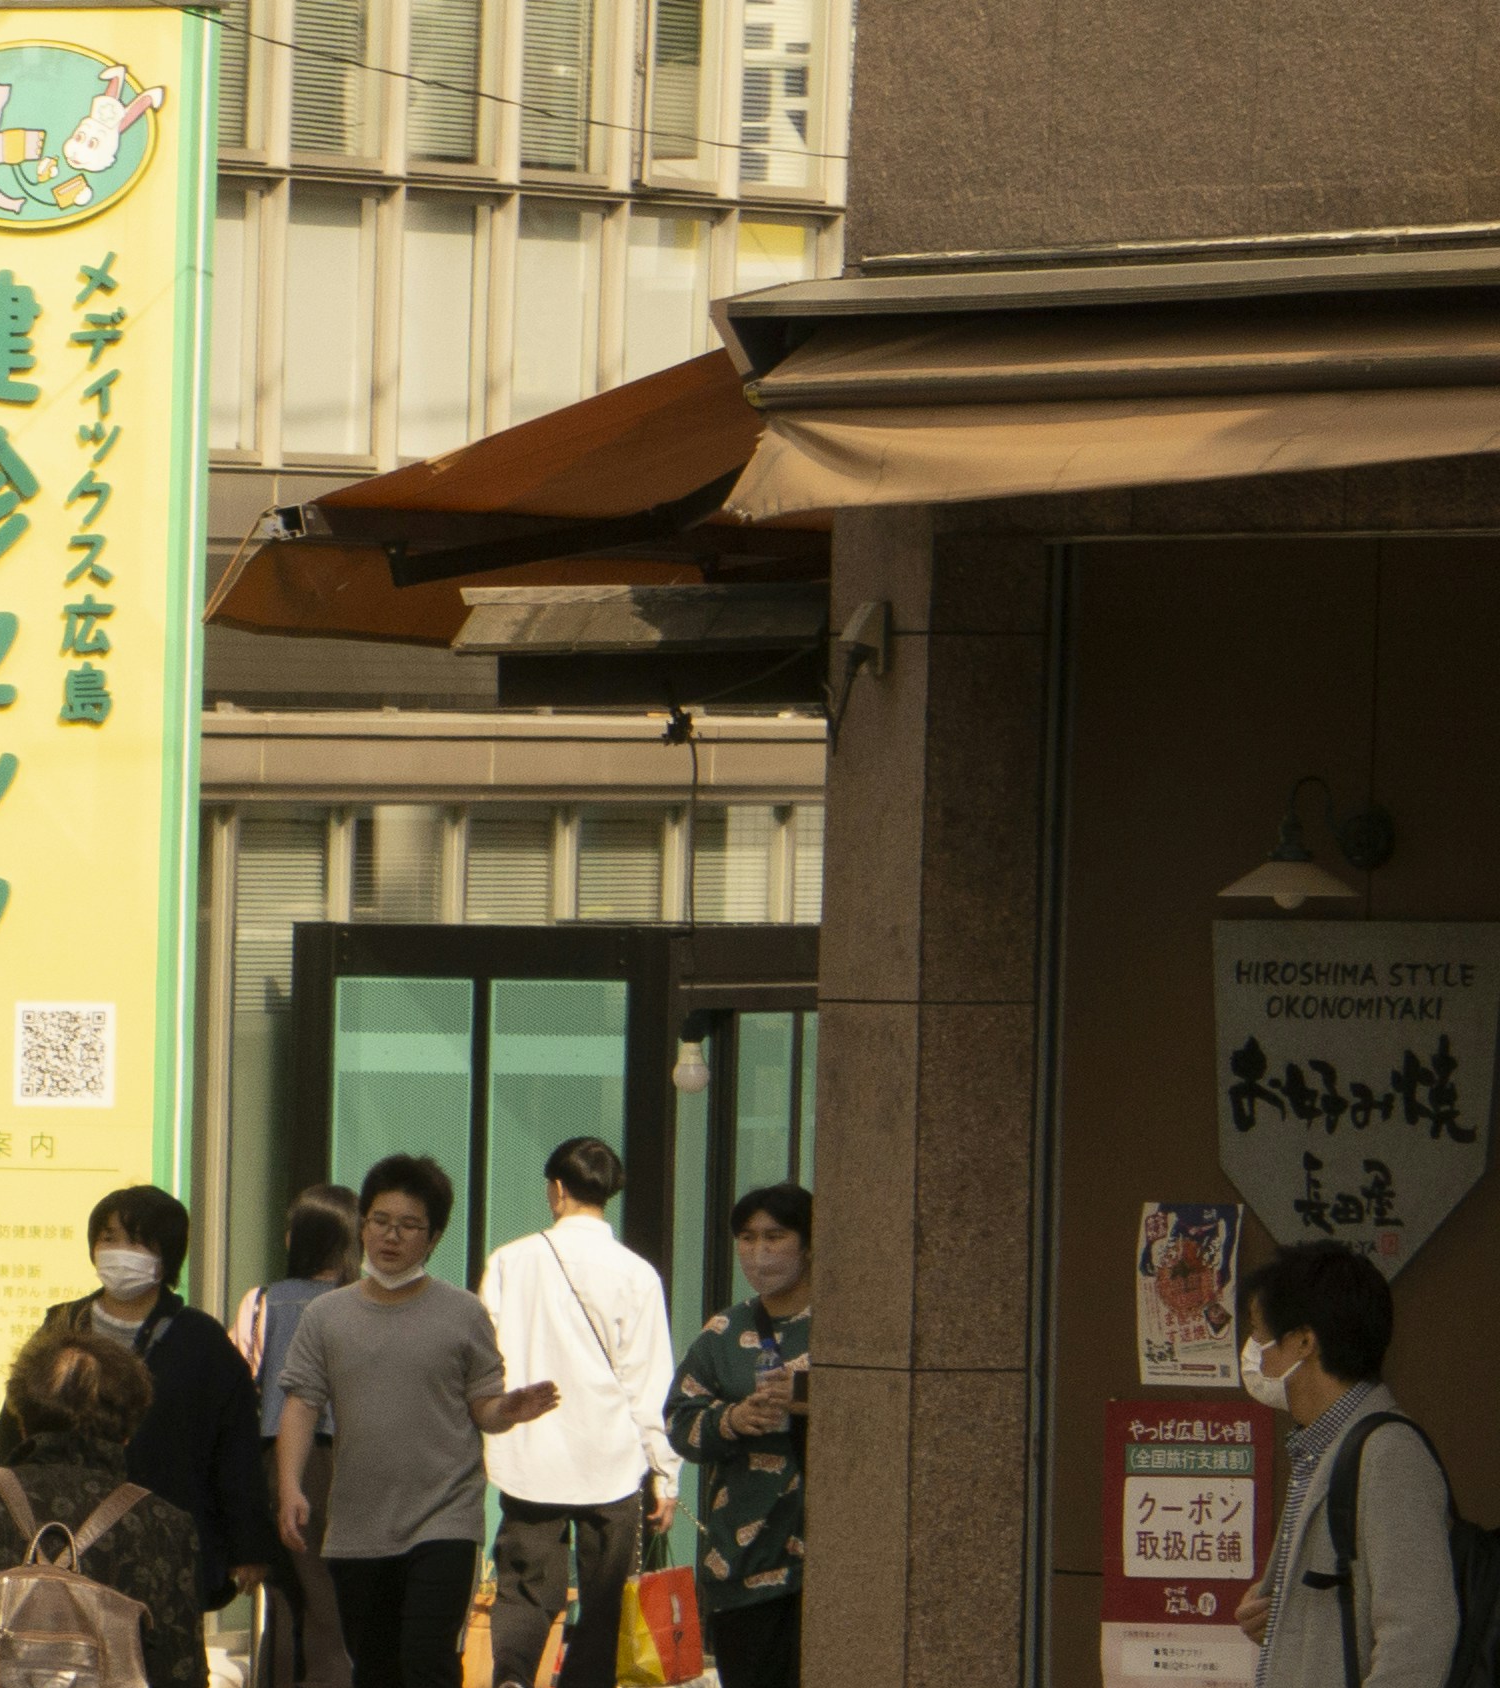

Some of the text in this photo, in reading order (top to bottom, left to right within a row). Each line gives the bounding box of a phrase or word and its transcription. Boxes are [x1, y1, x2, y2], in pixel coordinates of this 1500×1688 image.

[58, 250, 129, 726] メディックス広島
[1235, 959, 1476, 988] HIROSHIMA STYLE
[1265, 994, 1444, 1020] OKONOMIYAKI
[1138, 1491, 1242, 1525] クーポン
[1135, 1530, 1243, 1563] 取扱店舗
